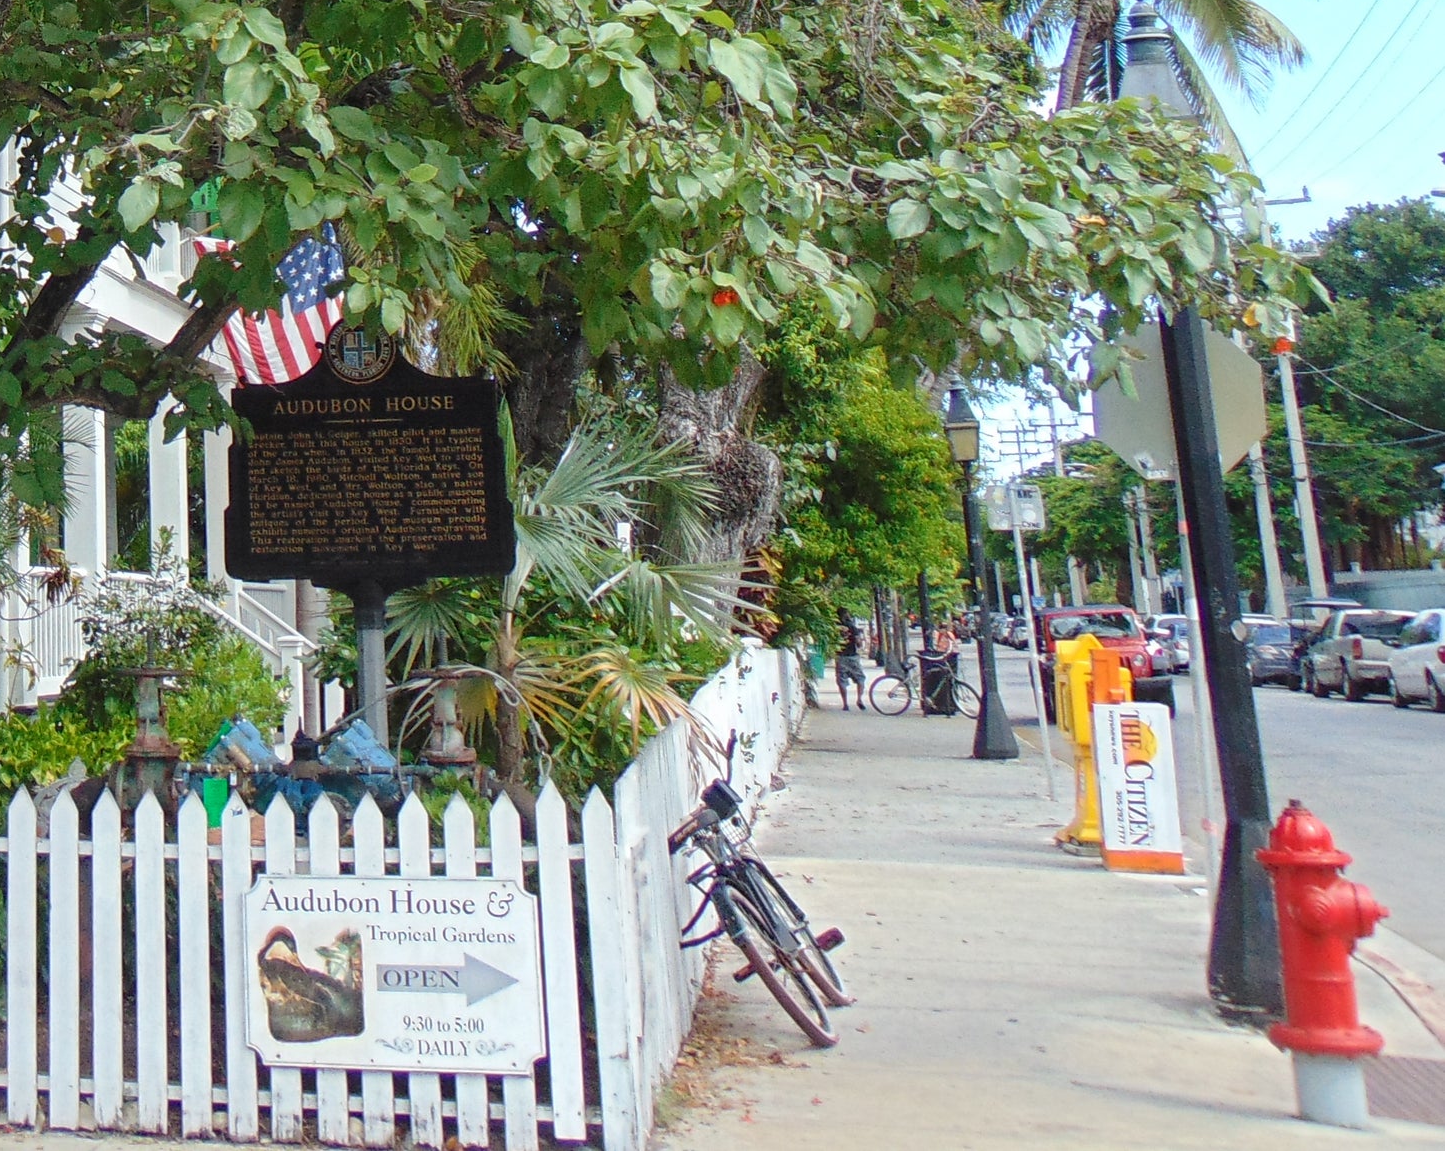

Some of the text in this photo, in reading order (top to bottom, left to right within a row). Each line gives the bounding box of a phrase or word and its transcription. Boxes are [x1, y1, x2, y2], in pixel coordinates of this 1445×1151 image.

[274, 396, 454, 415] AUDUBON HOUSE
[251, 433, 283, 441] aptain
[287, 431, 311, 439] John
[368, 429, 398, 437] skilled
[449, 436, 482, 444] typical
[402, 446, 430, 454] famed
[393, 455, 411, 463] Key
[456, 453, 483, 461] study
[327, 465, 351, 473] birds
[469, 461, 483, 469] On
[339, 474, 376, 482] Mitchell
[432, 471, 460, 479] native
[416, 489, 443, 498] public
[323, 500, 364, 508] Audubon
[412, 498, 485, 506] commemorating
[351, 509, 368, 517] Key
[410, 506, 456, 515] Furnished
[250, 519, 289, 528] antiques
[295, 518, 306, 526] of
[312, 518, 328, 526] the
[381, 516, 396, 524] the
[402, 516, 441, 524] museum
[448, 515, 486, 524] proudly
[341, 527, 379, 535] original
[384, 525, 426, 533] Audubon
[431, 525, 486, 533] engravings.
[401, 533, 463, 542] preservation
[470, 532, 486, 540] and
[385, 543, 403, 551] Key
[1119, 709, 1155, 846] THE CITIZEN
[261, 888, 514, 917] Audubon House &
[367, 924, 515, 945] Tropical Gardens
[383, 970, 460, 988] OPEN
[403, 1015, 484, 1033] 9:30 to 5:00
[417, 1039, 471, 1057] DAILY
